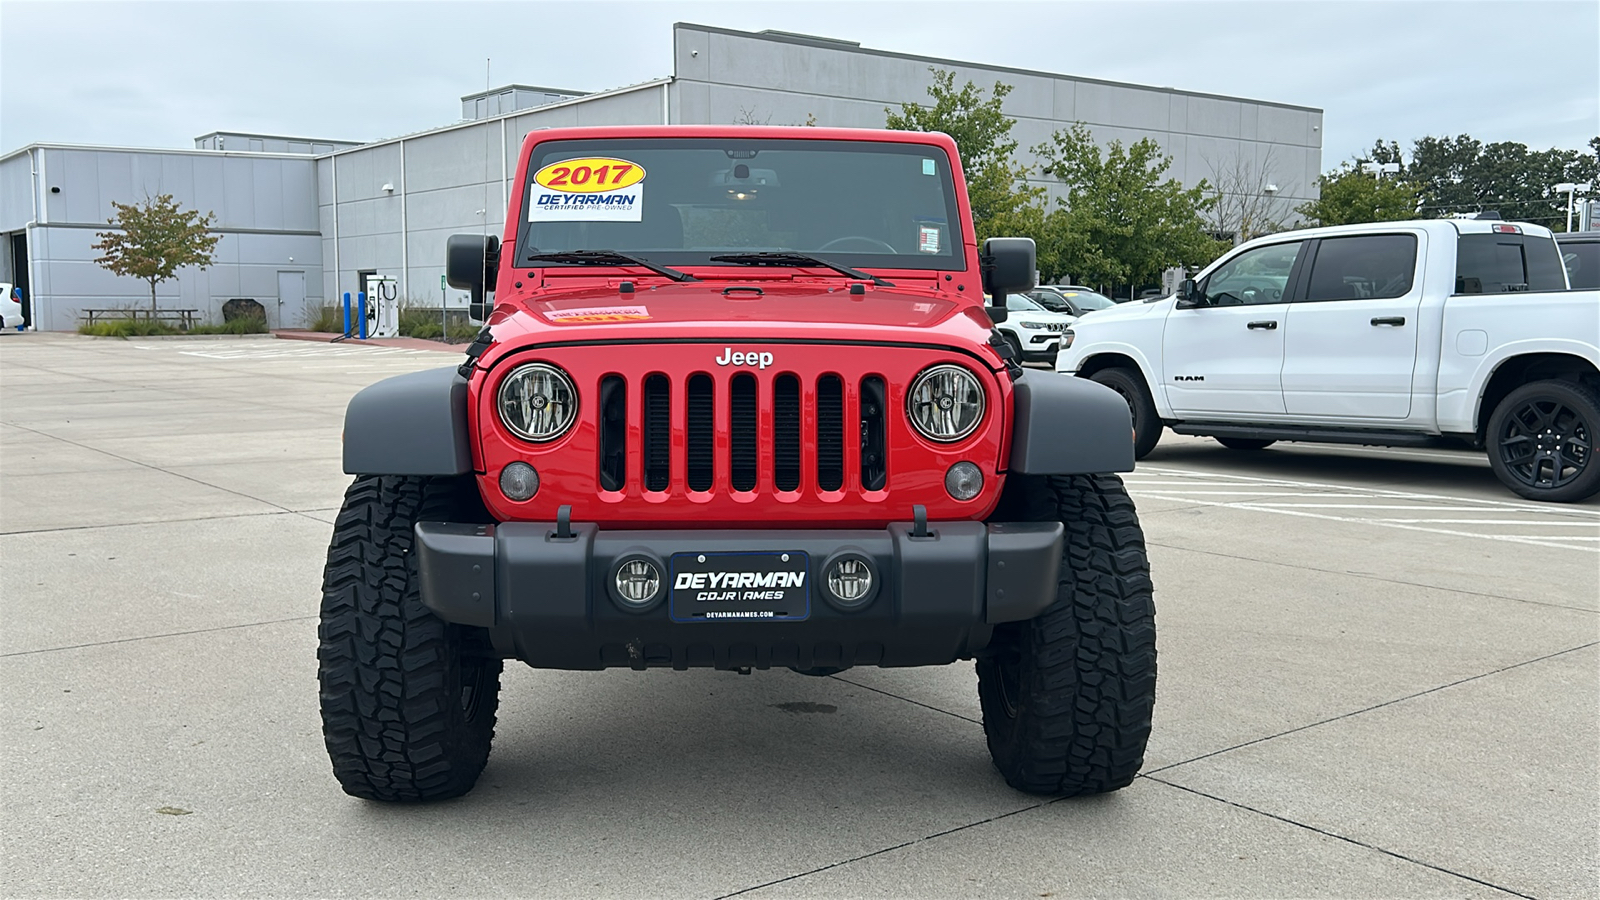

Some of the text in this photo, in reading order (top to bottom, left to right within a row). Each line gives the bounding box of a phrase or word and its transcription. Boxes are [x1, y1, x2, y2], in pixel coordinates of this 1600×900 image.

[547, 165, 632, 186] 2017
[537, 194, 636, 205] DEYARMAN
[715, 347, 774, 370] Jeep
[673, 571, 806, 590] DEYARMAN
[696, 590, 785, 601] CDJR AMES
